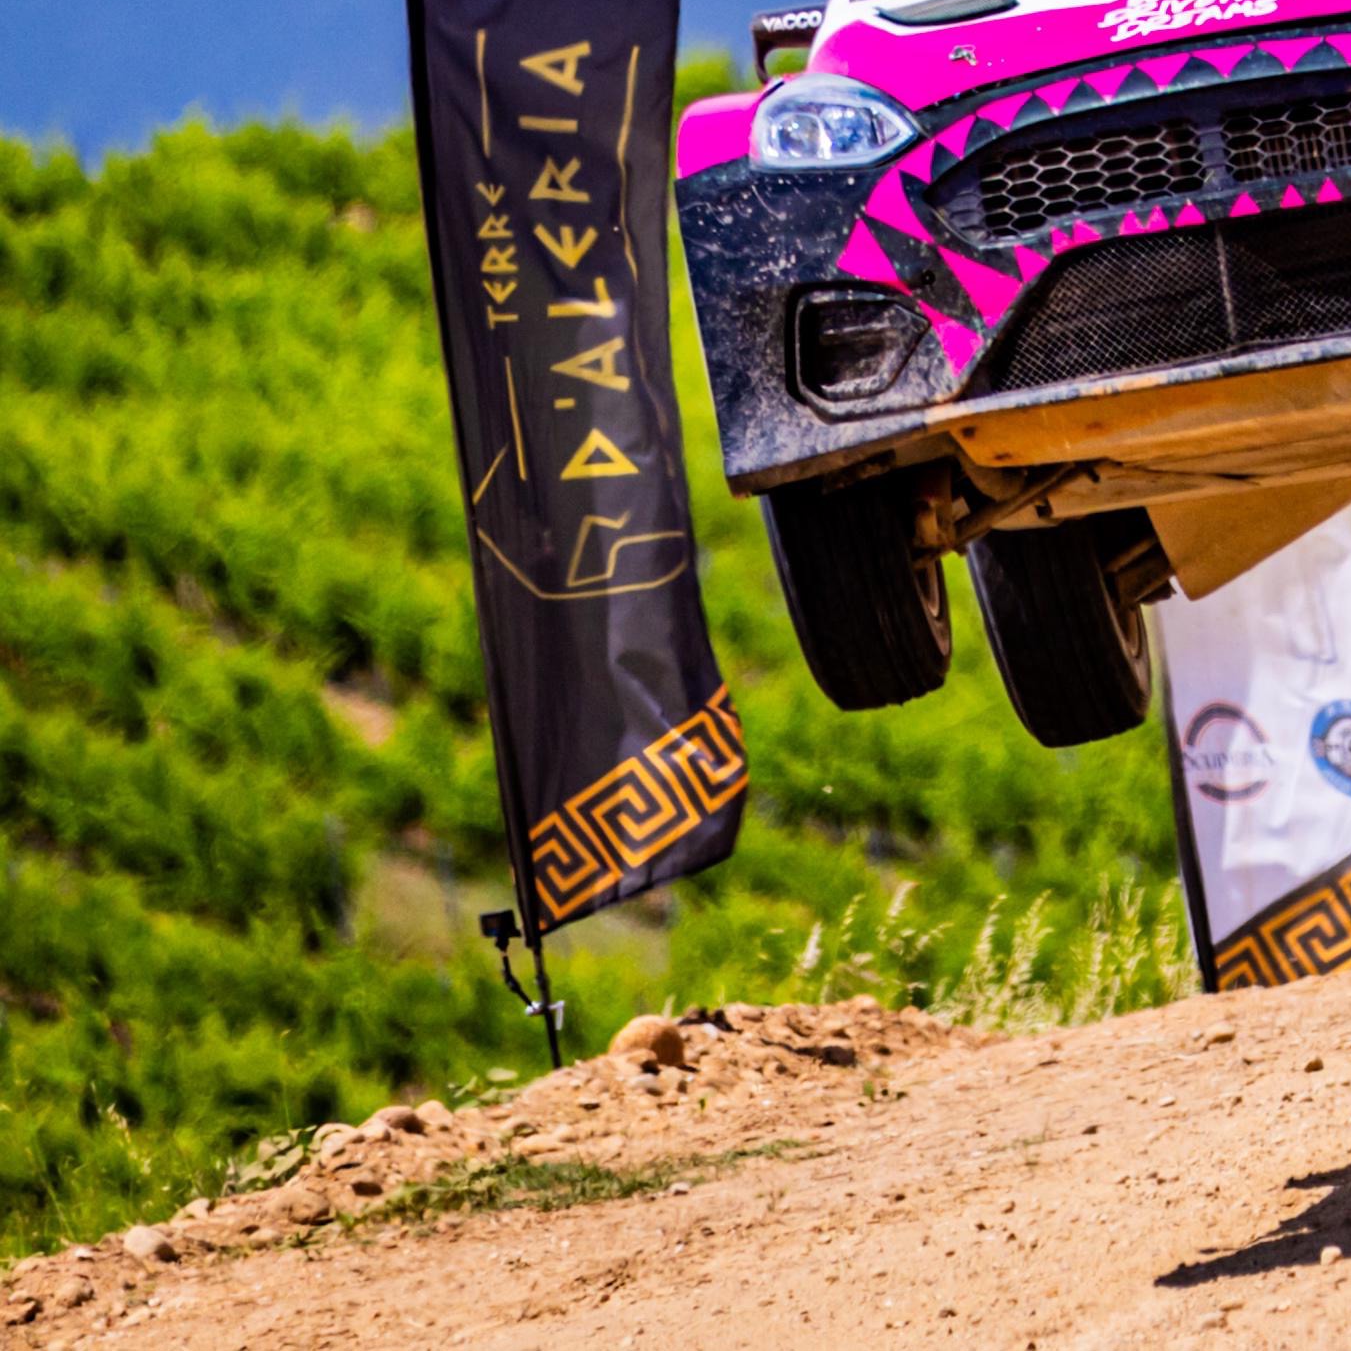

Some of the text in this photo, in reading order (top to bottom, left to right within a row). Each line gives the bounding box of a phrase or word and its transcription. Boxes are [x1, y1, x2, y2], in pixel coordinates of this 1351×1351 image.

[762, 10, 822, 33] YACCO
[475, 181, 519, 330] TERRE
[518, 41, 639, 480] D'ALERIA
